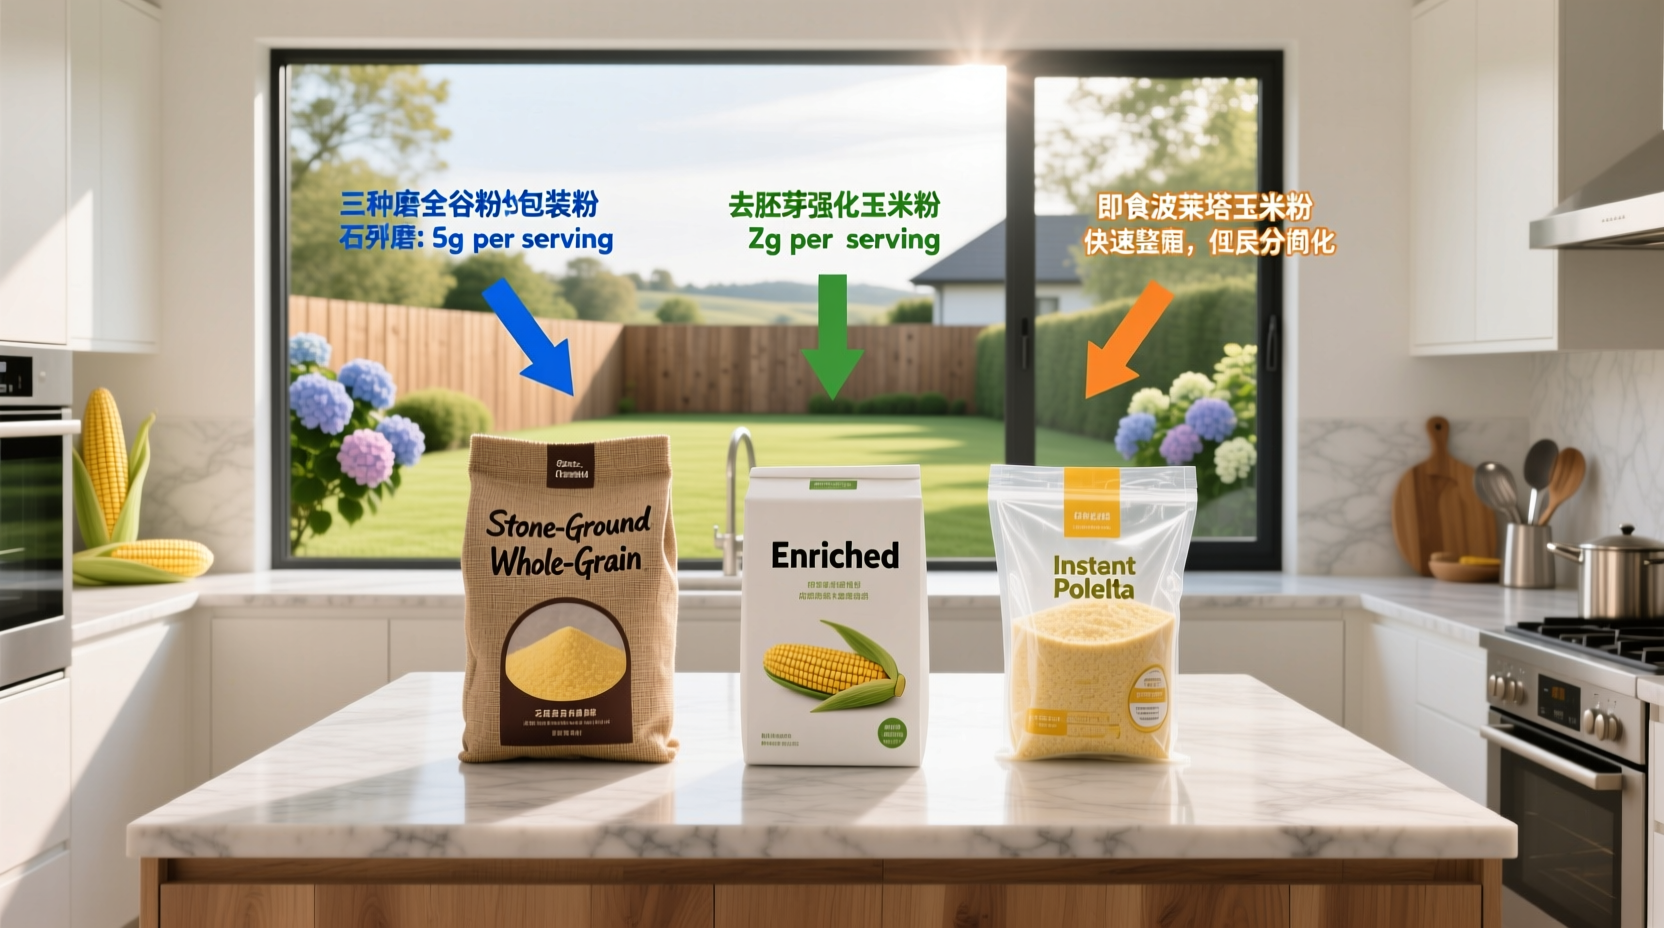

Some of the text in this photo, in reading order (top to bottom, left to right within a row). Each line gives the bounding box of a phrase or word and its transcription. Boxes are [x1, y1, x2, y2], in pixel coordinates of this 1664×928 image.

[486, 505, 652, 543] Stone-Ground
[491, 545, 642, 580] Whole-Grain
[772, 541, 899, 569] Enriched
[1054, 555, 1136, 575] Instant
